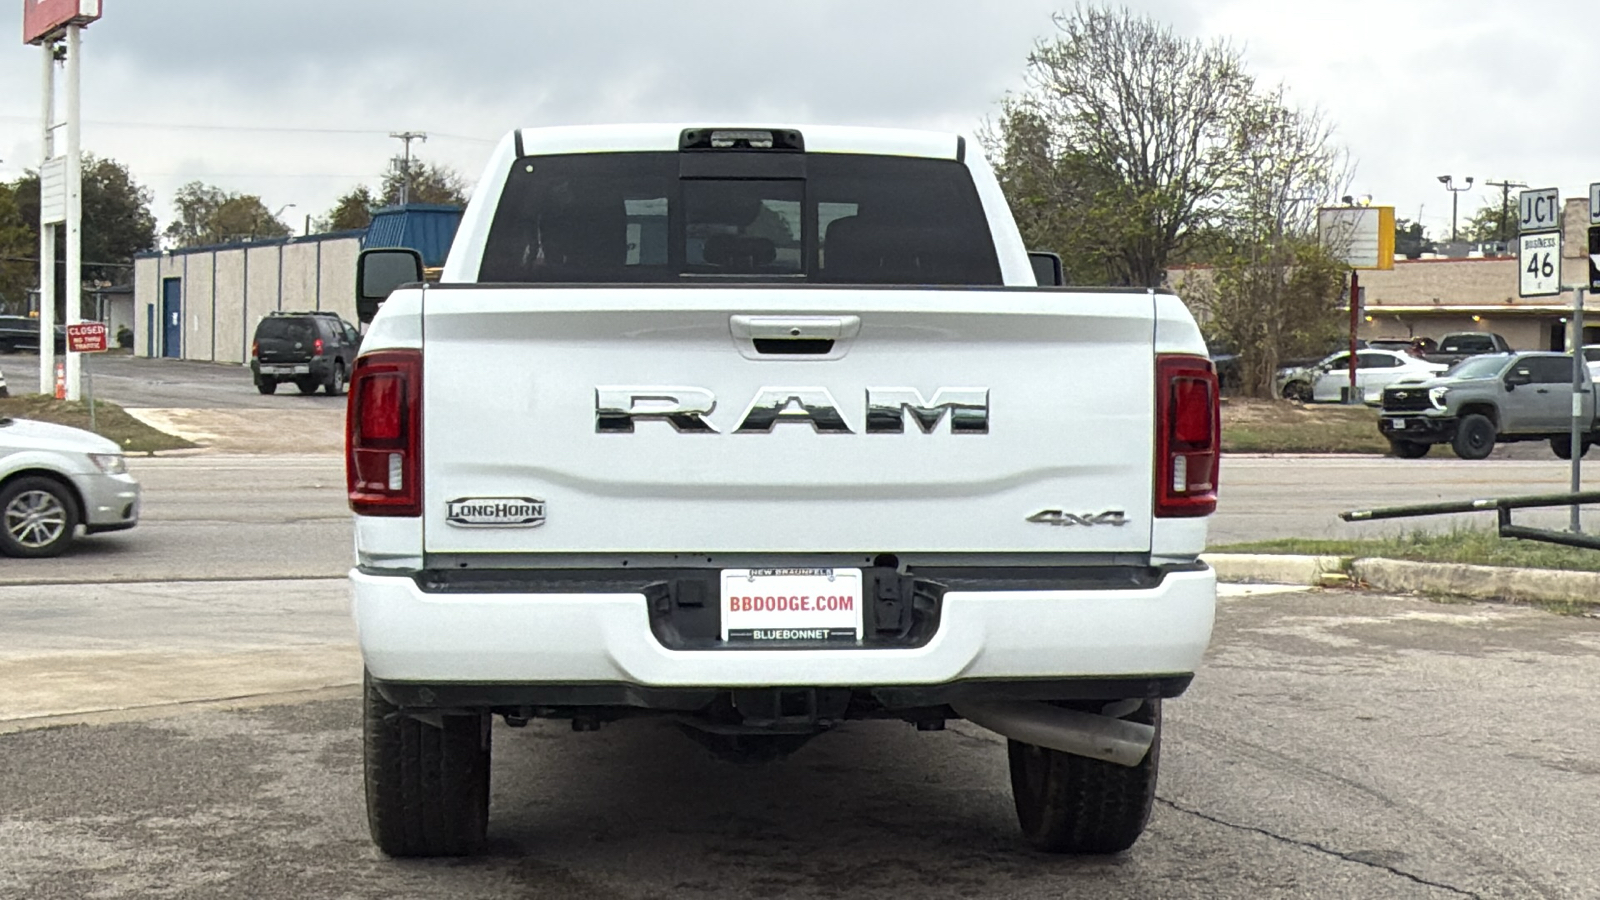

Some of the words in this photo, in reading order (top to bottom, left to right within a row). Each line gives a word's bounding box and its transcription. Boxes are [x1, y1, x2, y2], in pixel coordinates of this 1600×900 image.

[1523, 195, 1556, 224] JCT
[1525, 238, 1556, 250] BUSINESS
[1527, 252, 1554, 279] 46
[69, 325, 104, 336] CLOSED
[74, 342, 101, 350] TRAFFIC
[595, 385, 990, 434] RAM
[730, 595, 854, 612] BBDODGE.COM
[753, 629, 830, 640] BLUEBONNET
